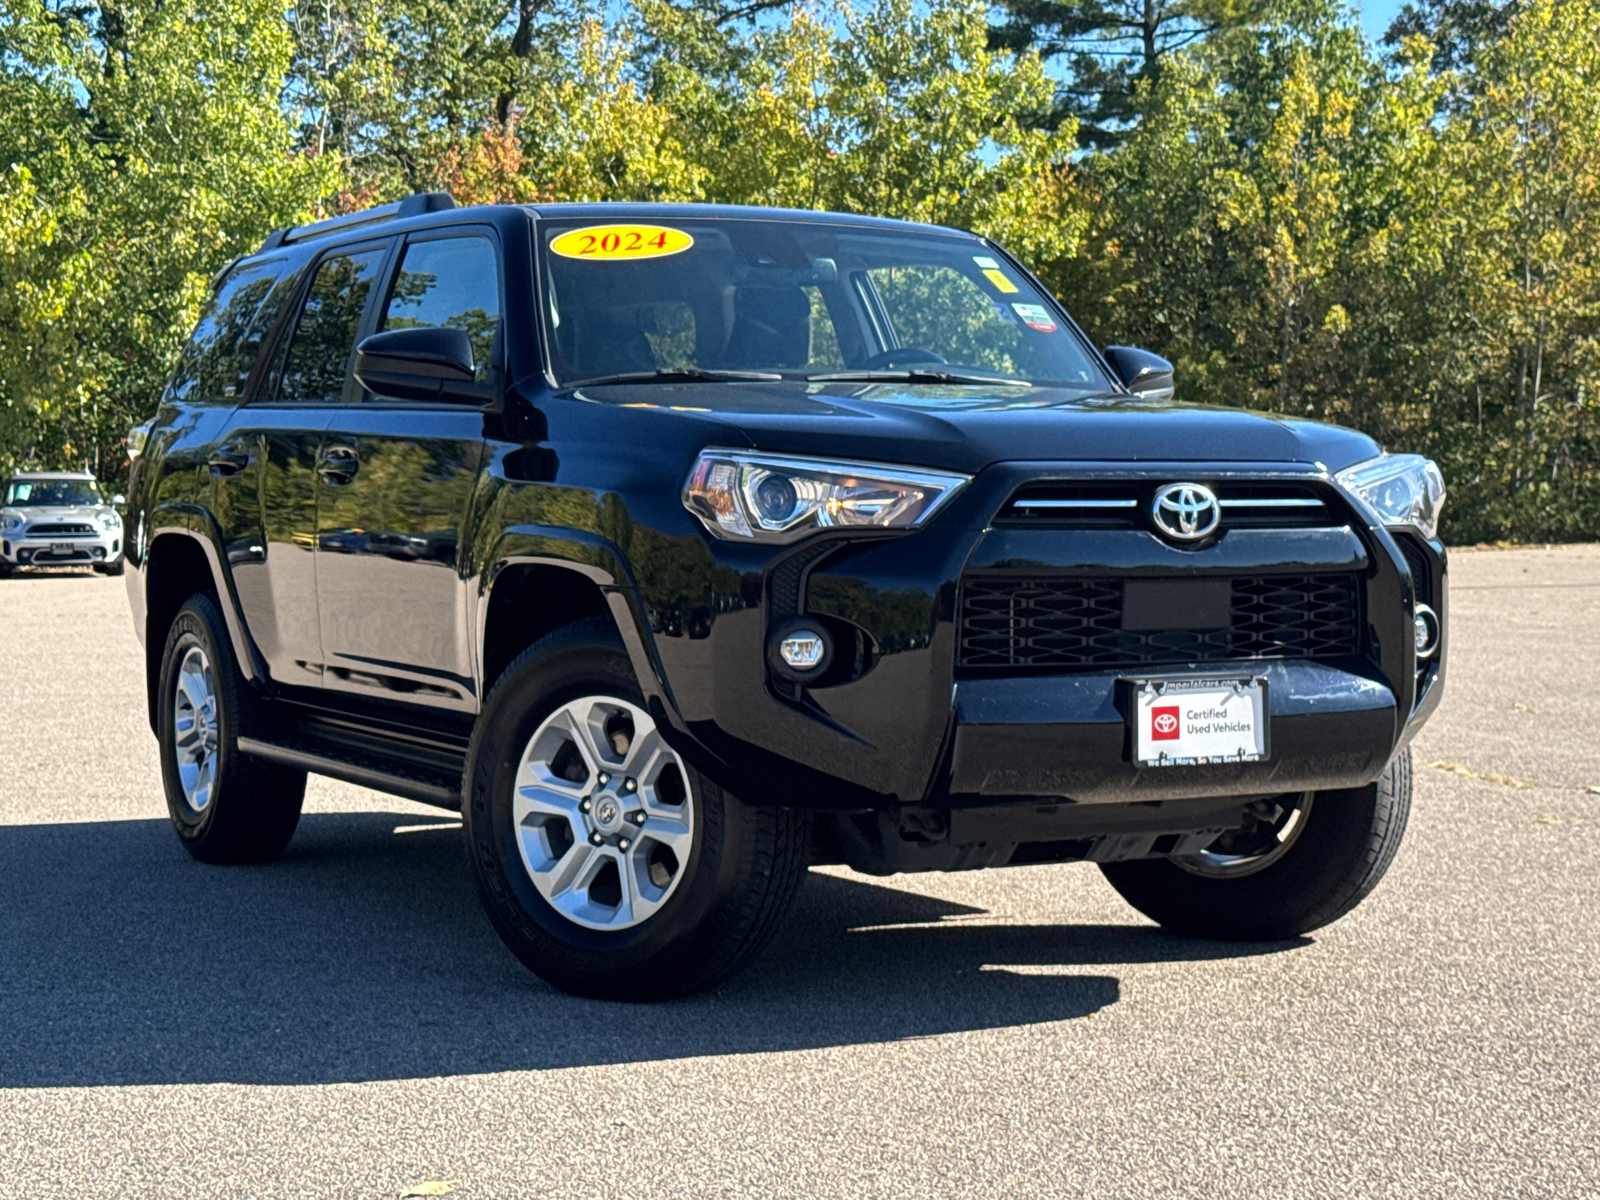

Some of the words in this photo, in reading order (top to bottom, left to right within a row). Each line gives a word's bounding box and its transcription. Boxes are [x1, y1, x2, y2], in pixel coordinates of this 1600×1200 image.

[578, 231, 668, 255] 2024
[1186, 708, 1228, 720] Certified
[1186, 723, 1211, 734] Used
[1213, 721, 1251, 733] Vehicles
[1147, 759, 1160, 767] We
[1161, 758, 1174, 767] Sell
[1176, 757, 1196, 766] More,
[1197, 756, 1207, 765] So
[1208, 756, 1222, 764] You
[1223, 755, 1240, 763] Save
[1241, 754, 1260, 762] More
